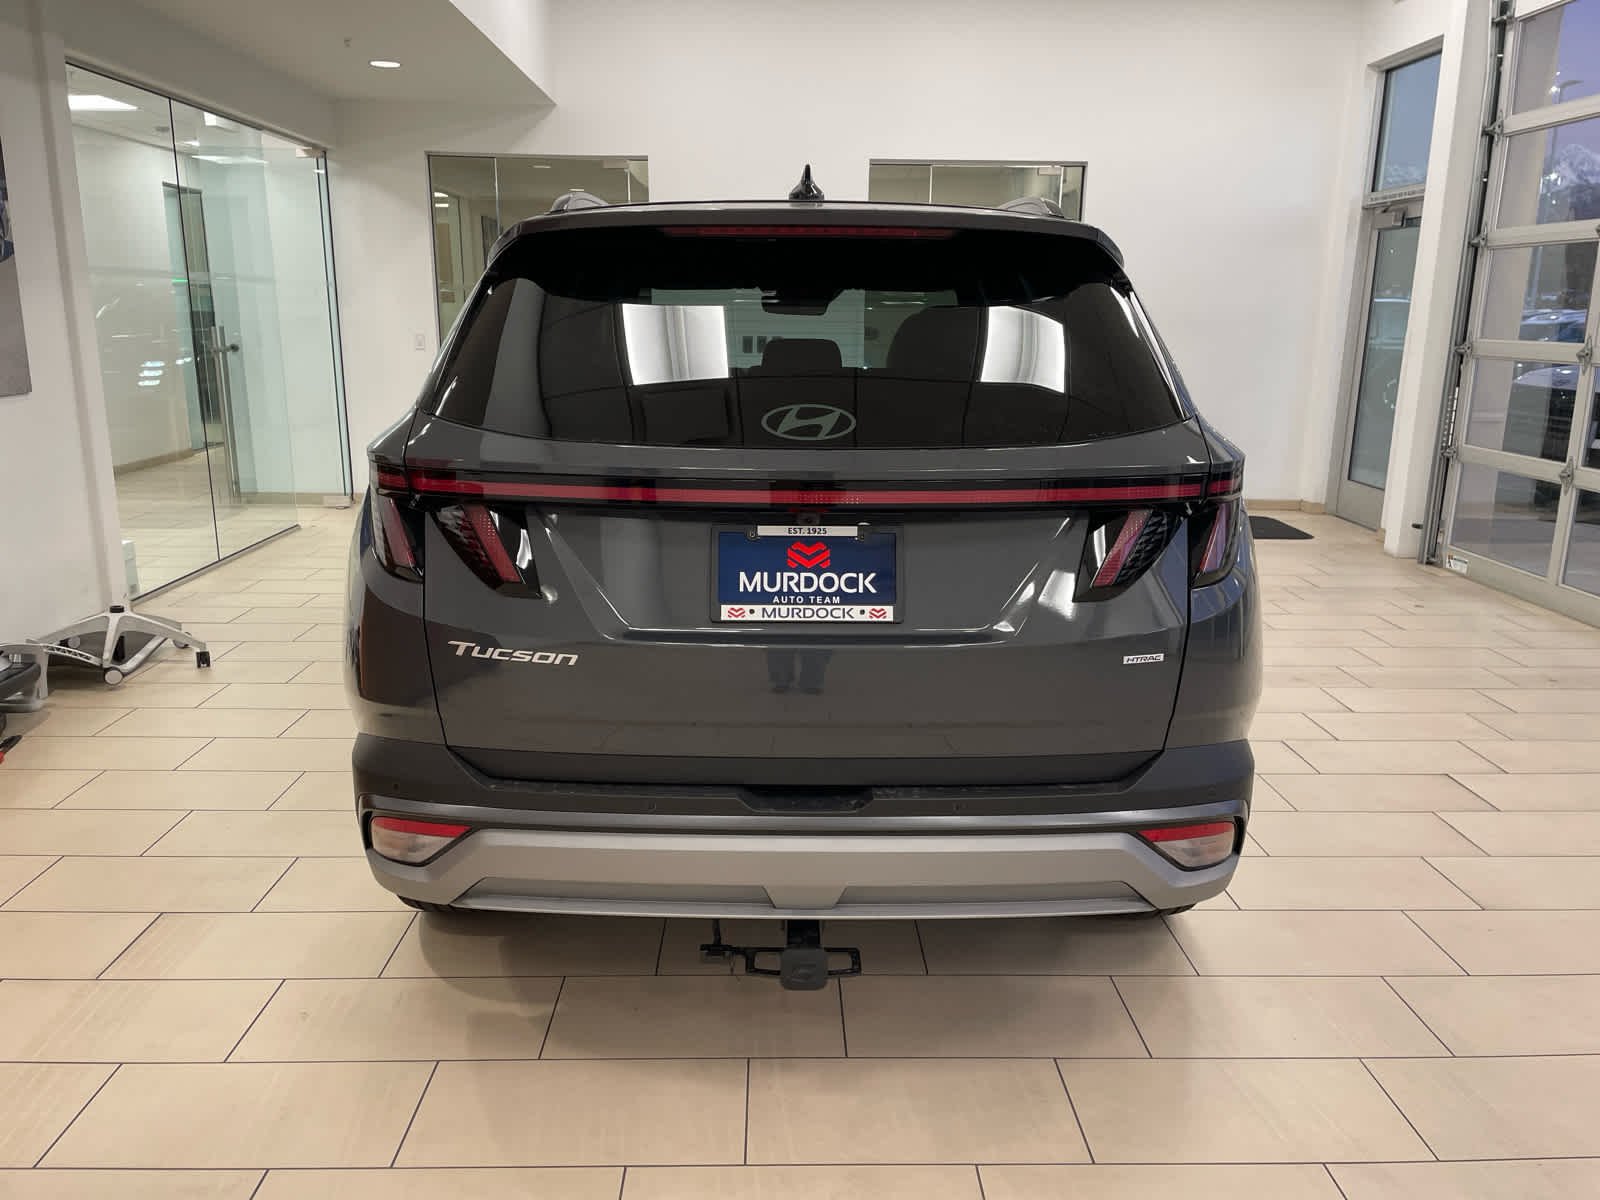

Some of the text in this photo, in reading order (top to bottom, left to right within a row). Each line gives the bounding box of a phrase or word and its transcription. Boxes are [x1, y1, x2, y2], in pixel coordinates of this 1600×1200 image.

[787, 527, 828, 535] EST. 1925
[739, 571, 877, 593] MURDOCK
[772, 595, 841, 604] AUTO TEAM
[761, 607, 854, 619] MURDOCK
